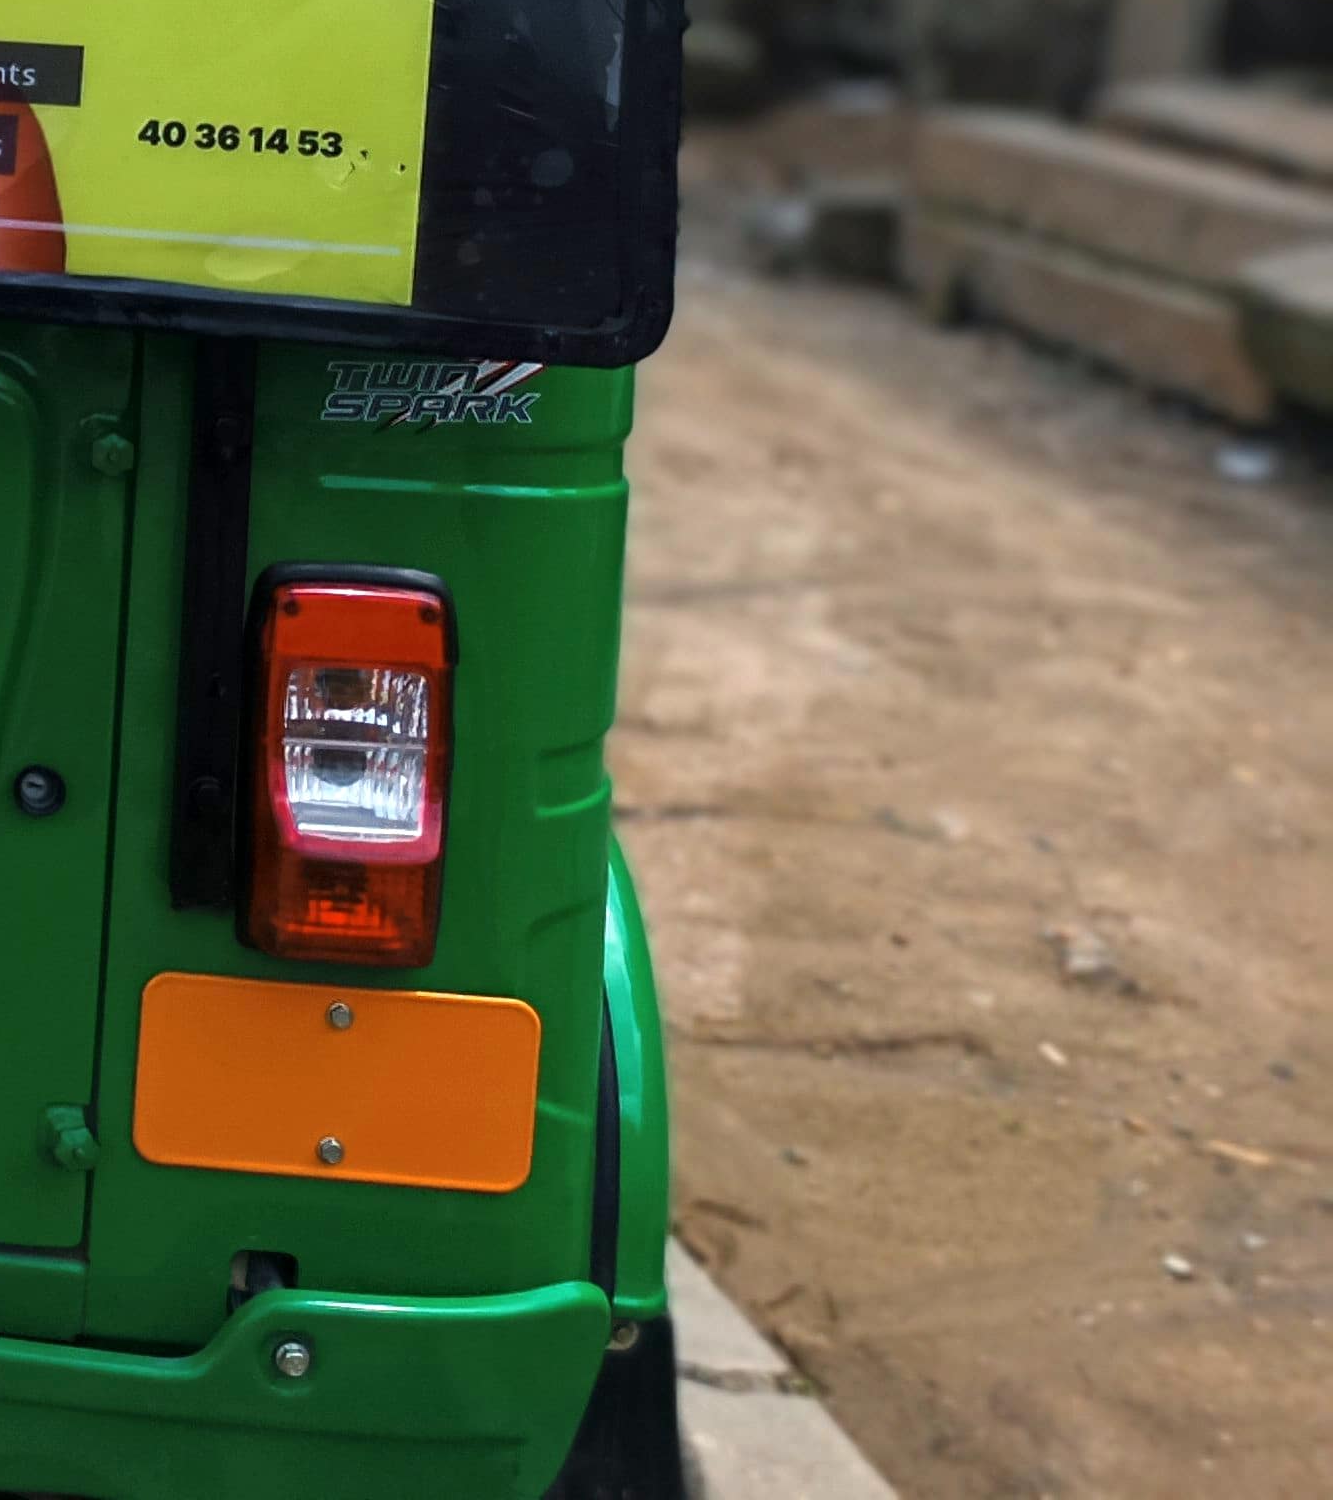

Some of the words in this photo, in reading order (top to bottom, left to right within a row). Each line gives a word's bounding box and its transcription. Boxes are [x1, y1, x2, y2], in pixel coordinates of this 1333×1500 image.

[137, 119, 187, 148] 40
[194, 123, 241, 151] 36
[248, 126, 290, 155] 14
[297, 129, 344, 158] 53
[327, 361, 481, 393] TWIN
[320, 391, 542, 424] SPARK
